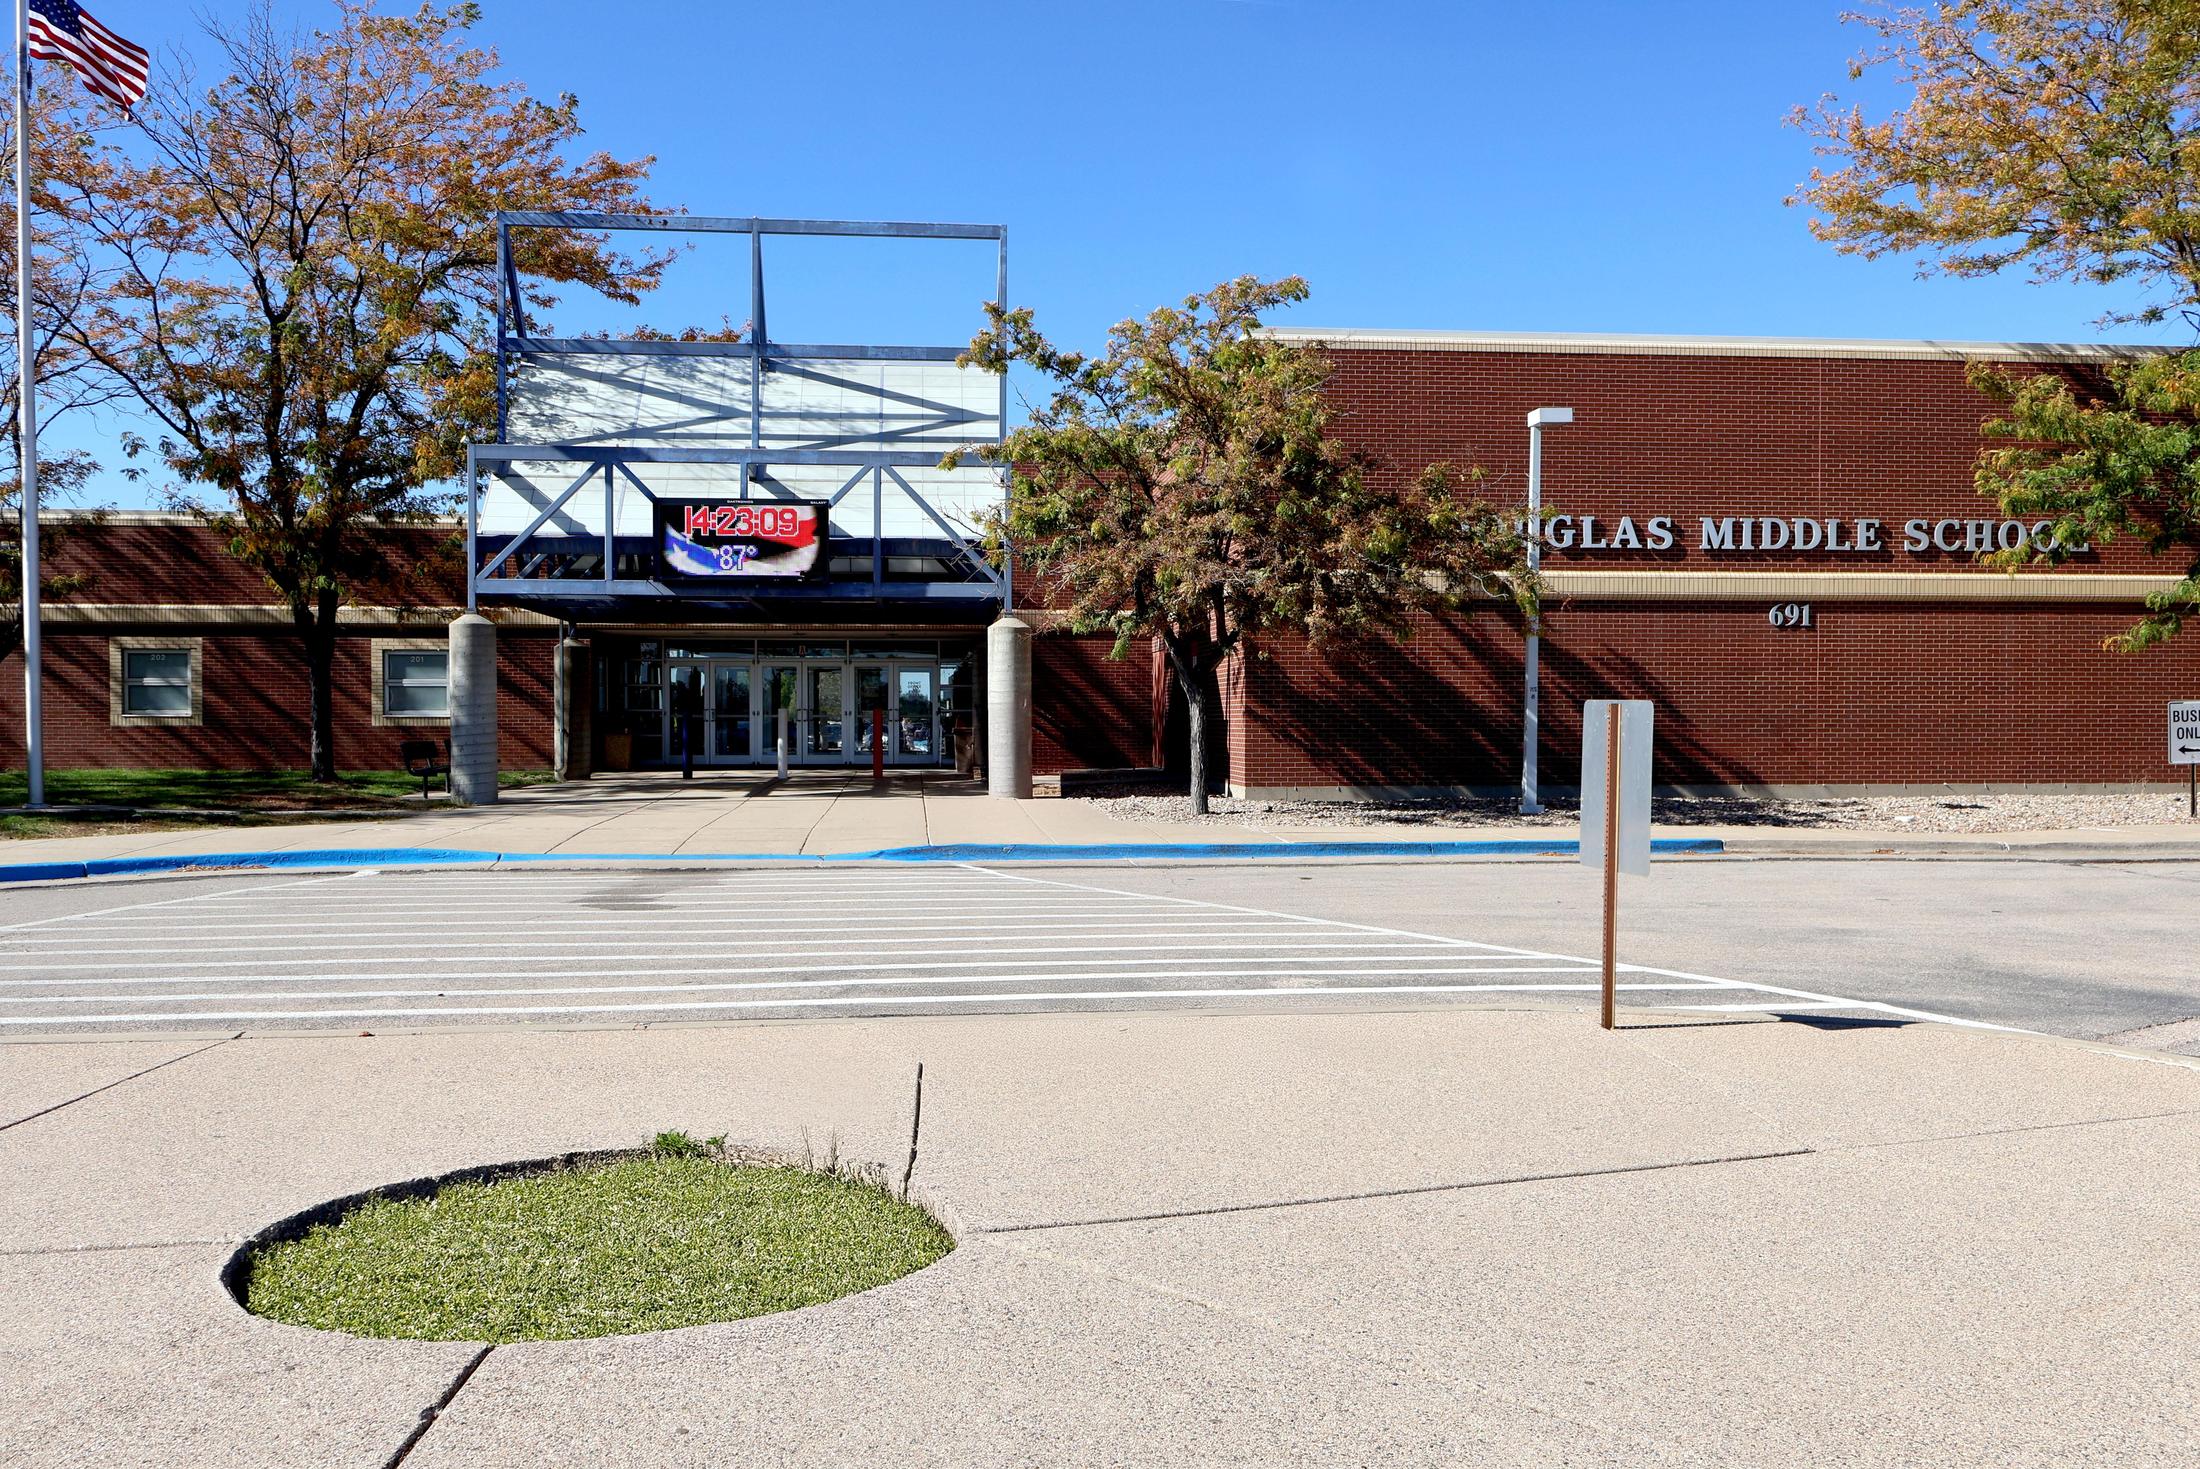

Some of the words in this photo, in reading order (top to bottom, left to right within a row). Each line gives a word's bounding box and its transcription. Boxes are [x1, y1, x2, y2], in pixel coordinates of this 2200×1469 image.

[684, 505, 799, 537] 14:23:09
[1505, 515, 1675, 551] GLAS
[1700, 516, 1882, 551] MIDDLE
[1768, 603, 1813, 627] 691
[2172, 709, 2200, 723] BUS
